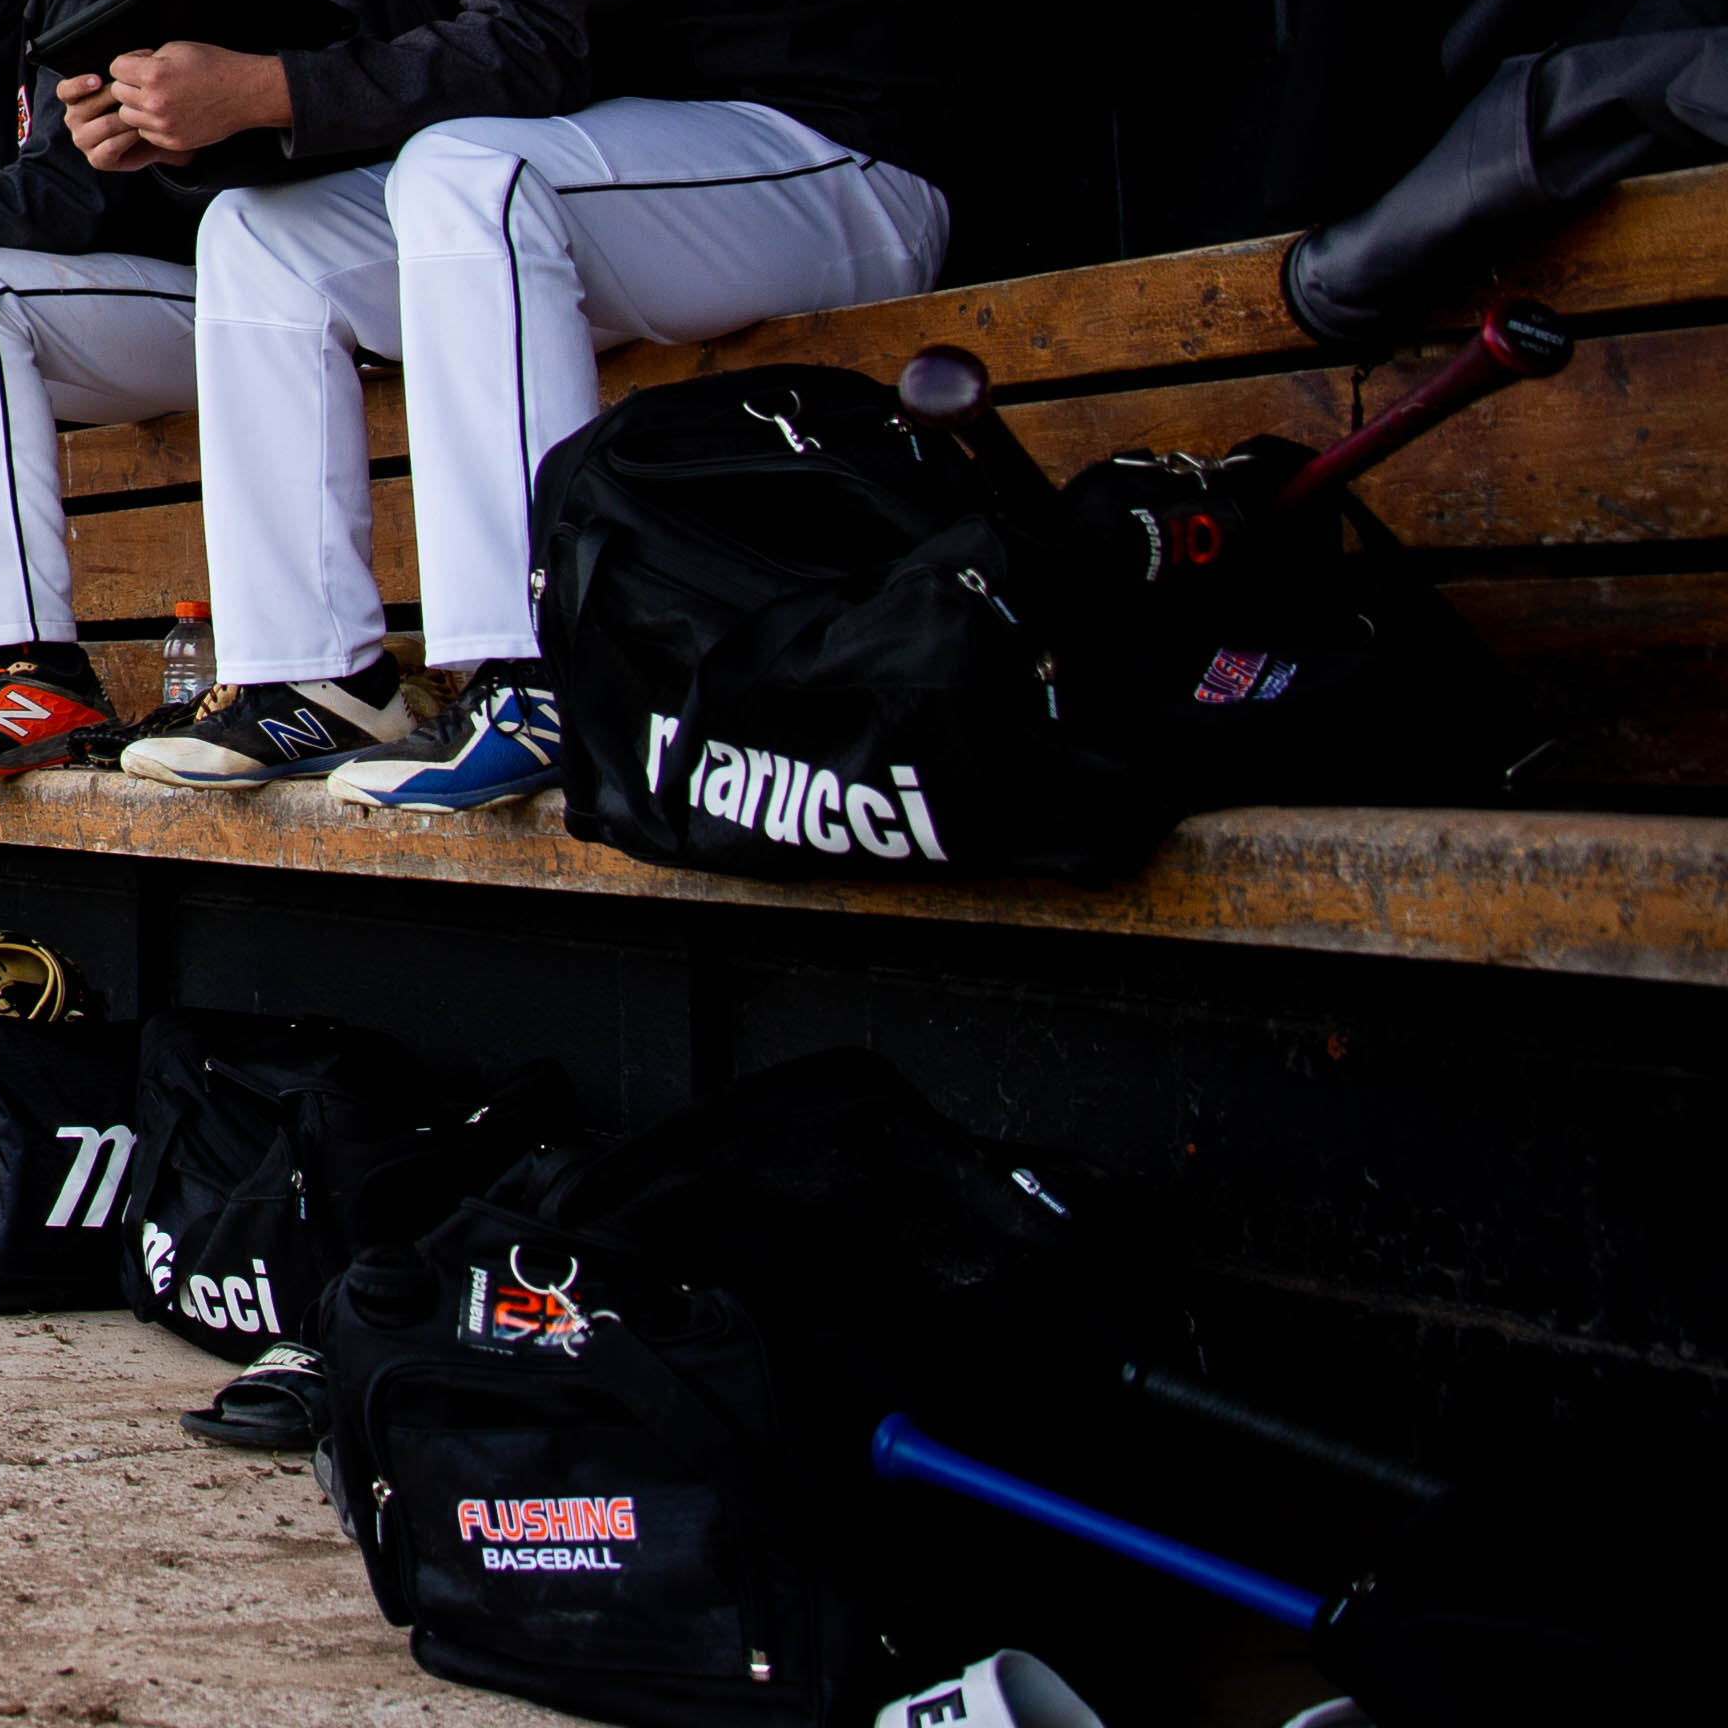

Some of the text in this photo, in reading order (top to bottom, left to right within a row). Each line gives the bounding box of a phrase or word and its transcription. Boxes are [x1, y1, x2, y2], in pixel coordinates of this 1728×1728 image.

[257, 707, 337, 761] N
[469, 1265, 489, 1335] marucci
[256, 1347, 317, 1369] NIKE
[457, 1496, 638, 1542] FLUSHING
[482, 1546, 623, 1571] BASEBALL
